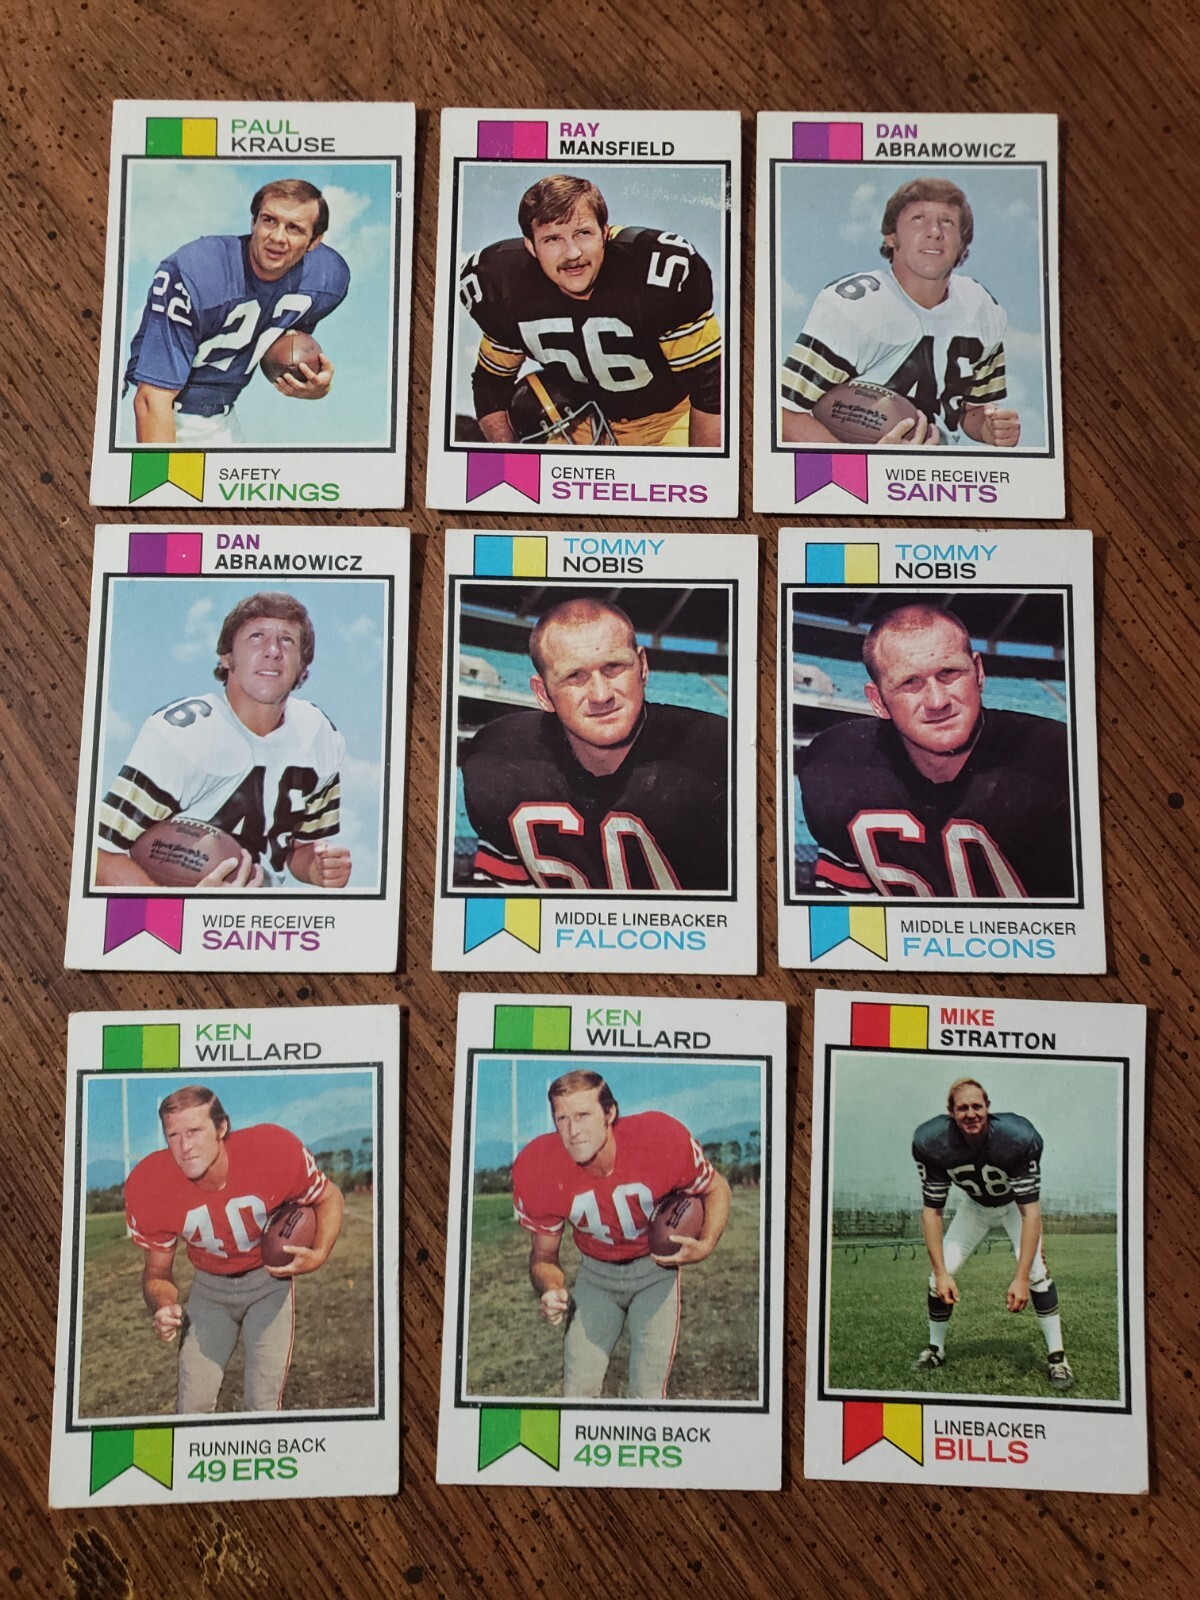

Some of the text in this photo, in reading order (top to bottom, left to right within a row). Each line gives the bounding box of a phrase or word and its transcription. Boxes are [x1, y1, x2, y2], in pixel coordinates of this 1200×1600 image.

[232, 120, 299, 134] PAUL
[560, 123, 599, 137] RAY
[877, 124, 917, 138] DAN
[232, 137, 335, 152] KRAUSE
[560, 141, 674, 156] MANSFIELD
[875, 143, 1015, 158] ABRAMOWICZ
[518, 317, 654, 392] 56
[219, 468, 280, 480] SAFETY
[552, 467, 615, 480] CENTER
[885, 469, 1010, 483] WIDE RECEIVER
[219, 483, 340, 501] VIKINGS
[552, 481, 708, 503] STEELERS
[888, 483, 997, 503] SAINTS
[217, 534, 259, 549] DAN
[564, 538, 664, 555] TOMMY
[896, 545, 997, 560] TOMMY
[215, 554, 362, 571] ABRAMOWICZ
[564, 557, 643, 573] NOBIS
[896, 563, 976, 579] NOBIS
[508, 801, 683, 891] 60
[847, 808, 1029, 899] 60
[203, 915, 335, 928] WIDE RECEIVER
[556, 912, 727, 927] MIDDLE LINEBACKER
[901, 920, 1076, 935] MIDDLE LINEBACKER
[202, 930, 320, 951] SAINTS
[557, 929, 706, 950] FALCONS
[904, 937, 1055, 959] FALCONS
[587, 1009, 641, 1026] KEN
[941, 1008, 994, 1026] MIKE
[196, 1024, 251, 1041] KEN
[586, 1029, 710, 1049] WILLARD
[941, 1029, 1055, 1050] STRATTON
[195, 1043, 321, 1061] WILLARD
[946, 1163, 1012, 1197] 58
[568, 1182, 655, 1246] 40
[182, 1194, 267, 1259] 40
[576, 1425, 710, 1442] RUNNING BACK
[935, 1420, 1046, 1439] LINEBACKER
[190, 1438, 325, 1457] RUNNING BACK
[935, 1438, 1028, 1464] BILLS
